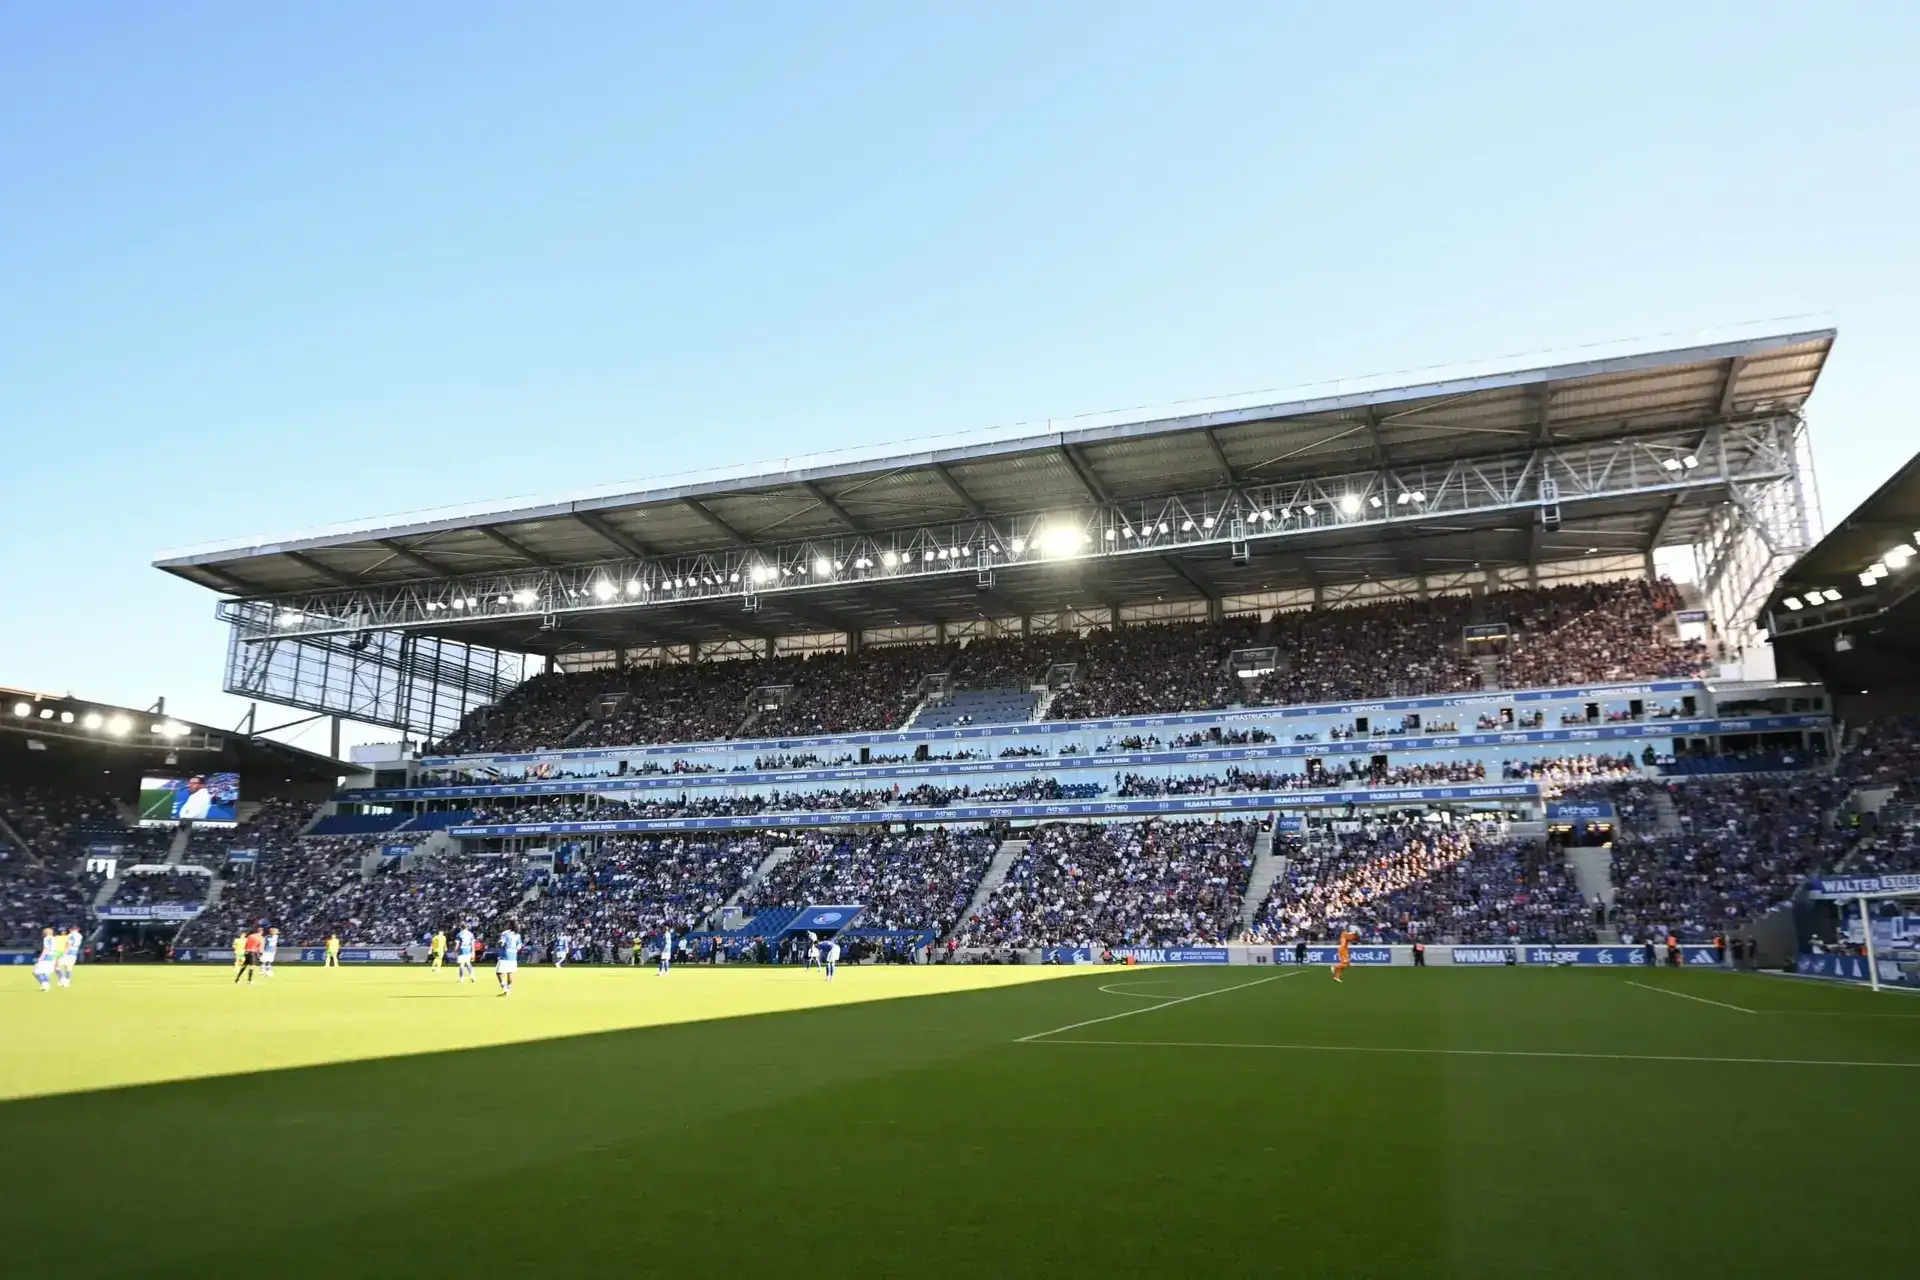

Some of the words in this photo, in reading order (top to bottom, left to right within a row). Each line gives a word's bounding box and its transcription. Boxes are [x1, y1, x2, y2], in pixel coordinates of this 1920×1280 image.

[1351, 704, 1385, 712] SERVICES
[1225, 711, 1283, 721] INFRASTRUCTURE
[1821, 878, 1880, 892] WALTER
[111, 907, 150, 915] WALTER
[1280, 948, 1324, 963] :hger
